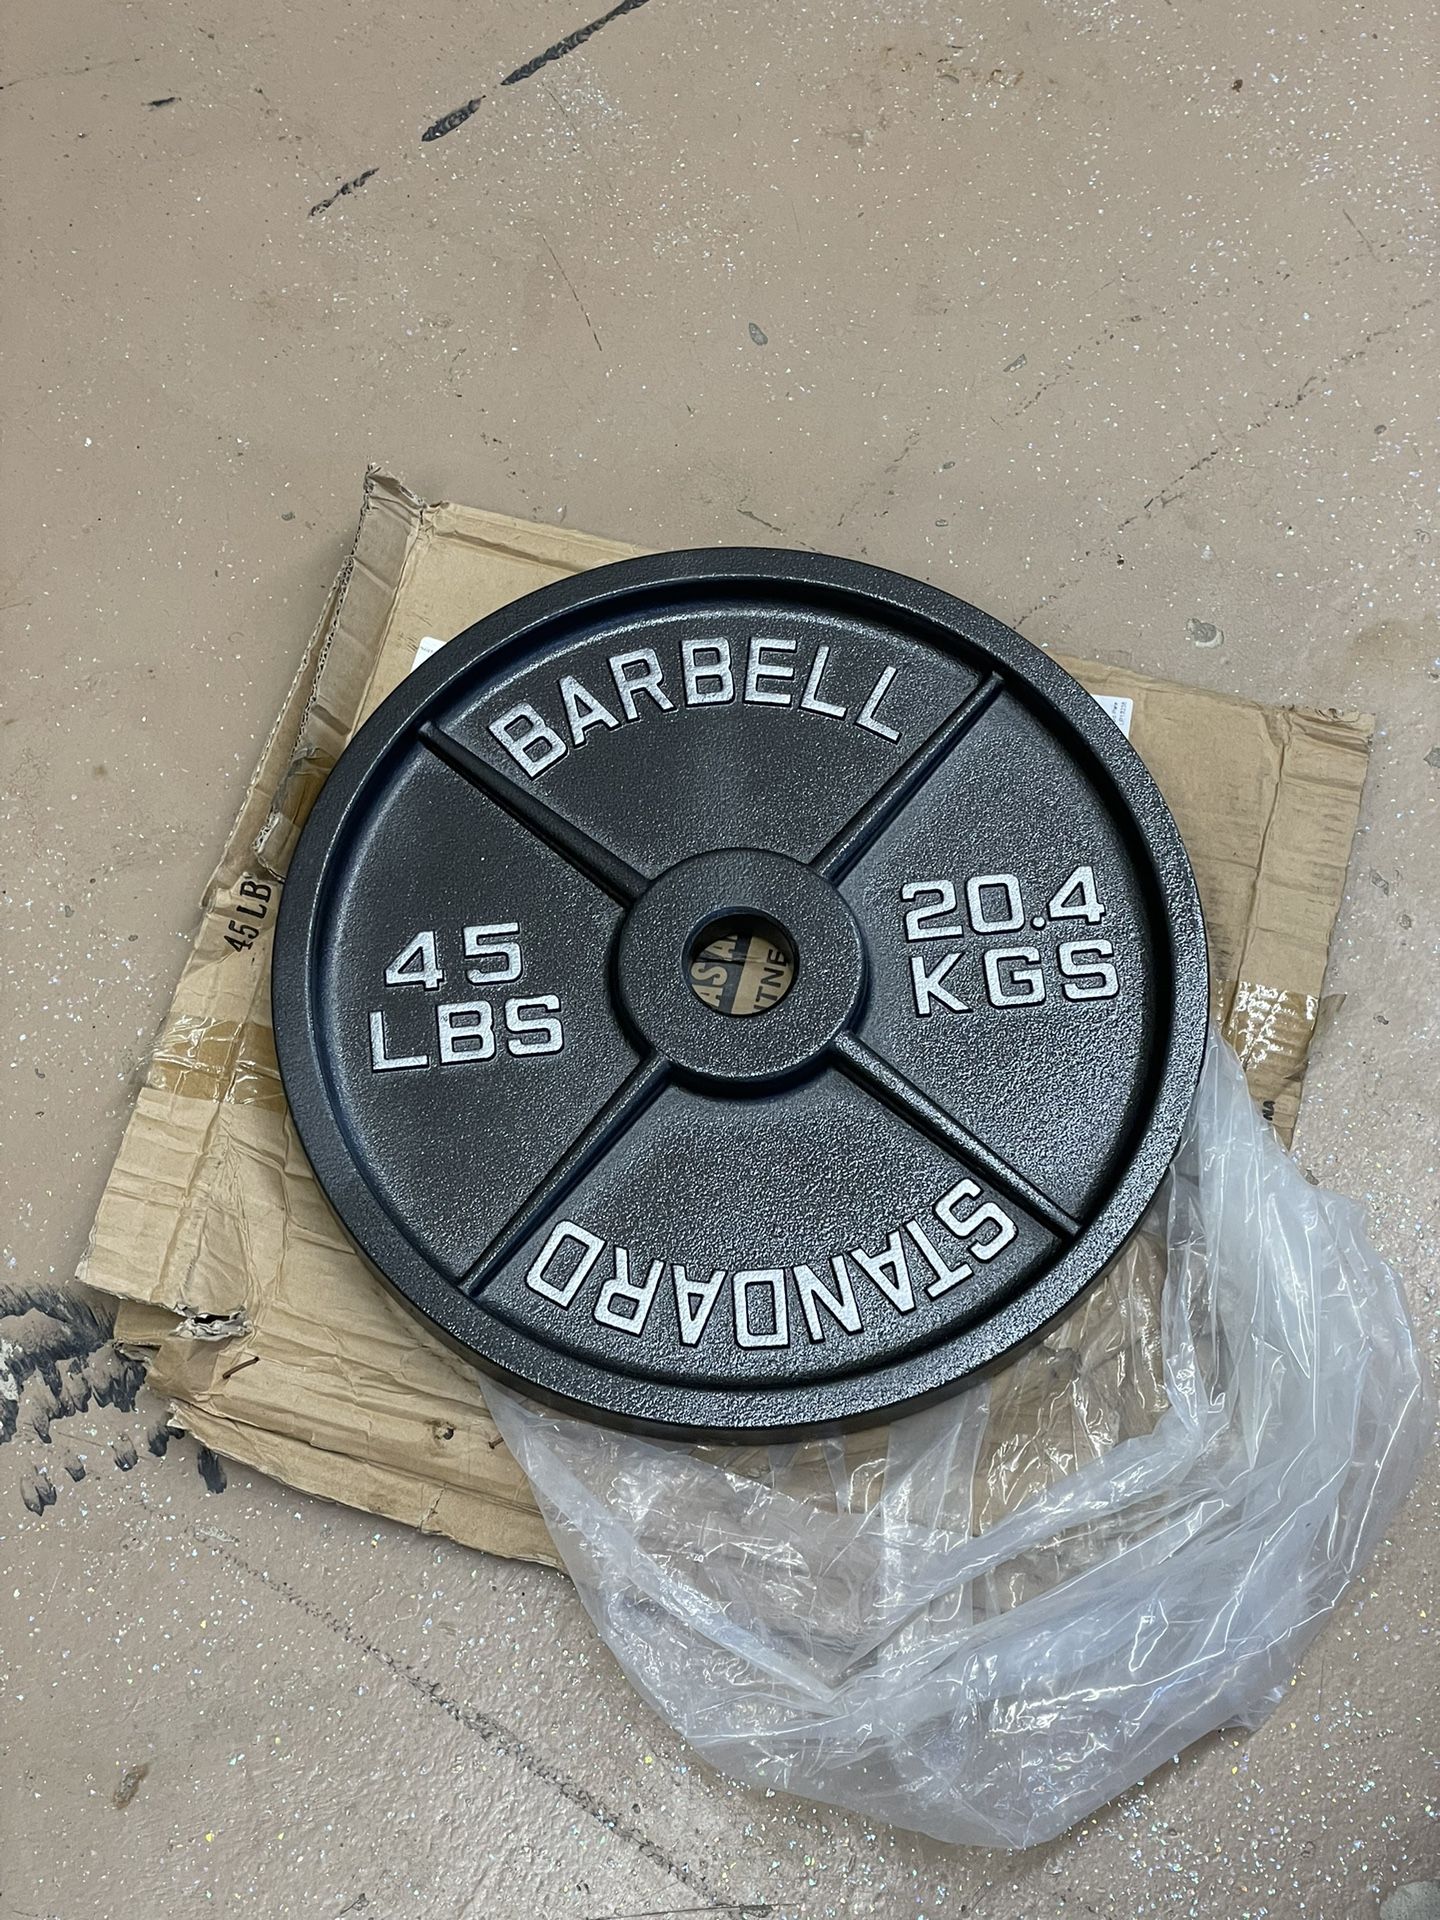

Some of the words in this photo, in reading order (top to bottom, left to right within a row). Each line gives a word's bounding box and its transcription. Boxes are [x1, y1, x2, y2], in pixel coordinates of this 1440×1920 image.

[487, 636, 902, 780] BARBELL
[224, 920, 259, 952] 45
[901, 865, 1107, 943] 20.4
[384, 922, 524, 991] 45
[909, 939, 1120, 1019] KGS
[368, 994, 565, 1074] LBS
[524, 1177, 1021, 1350] STANDARD
